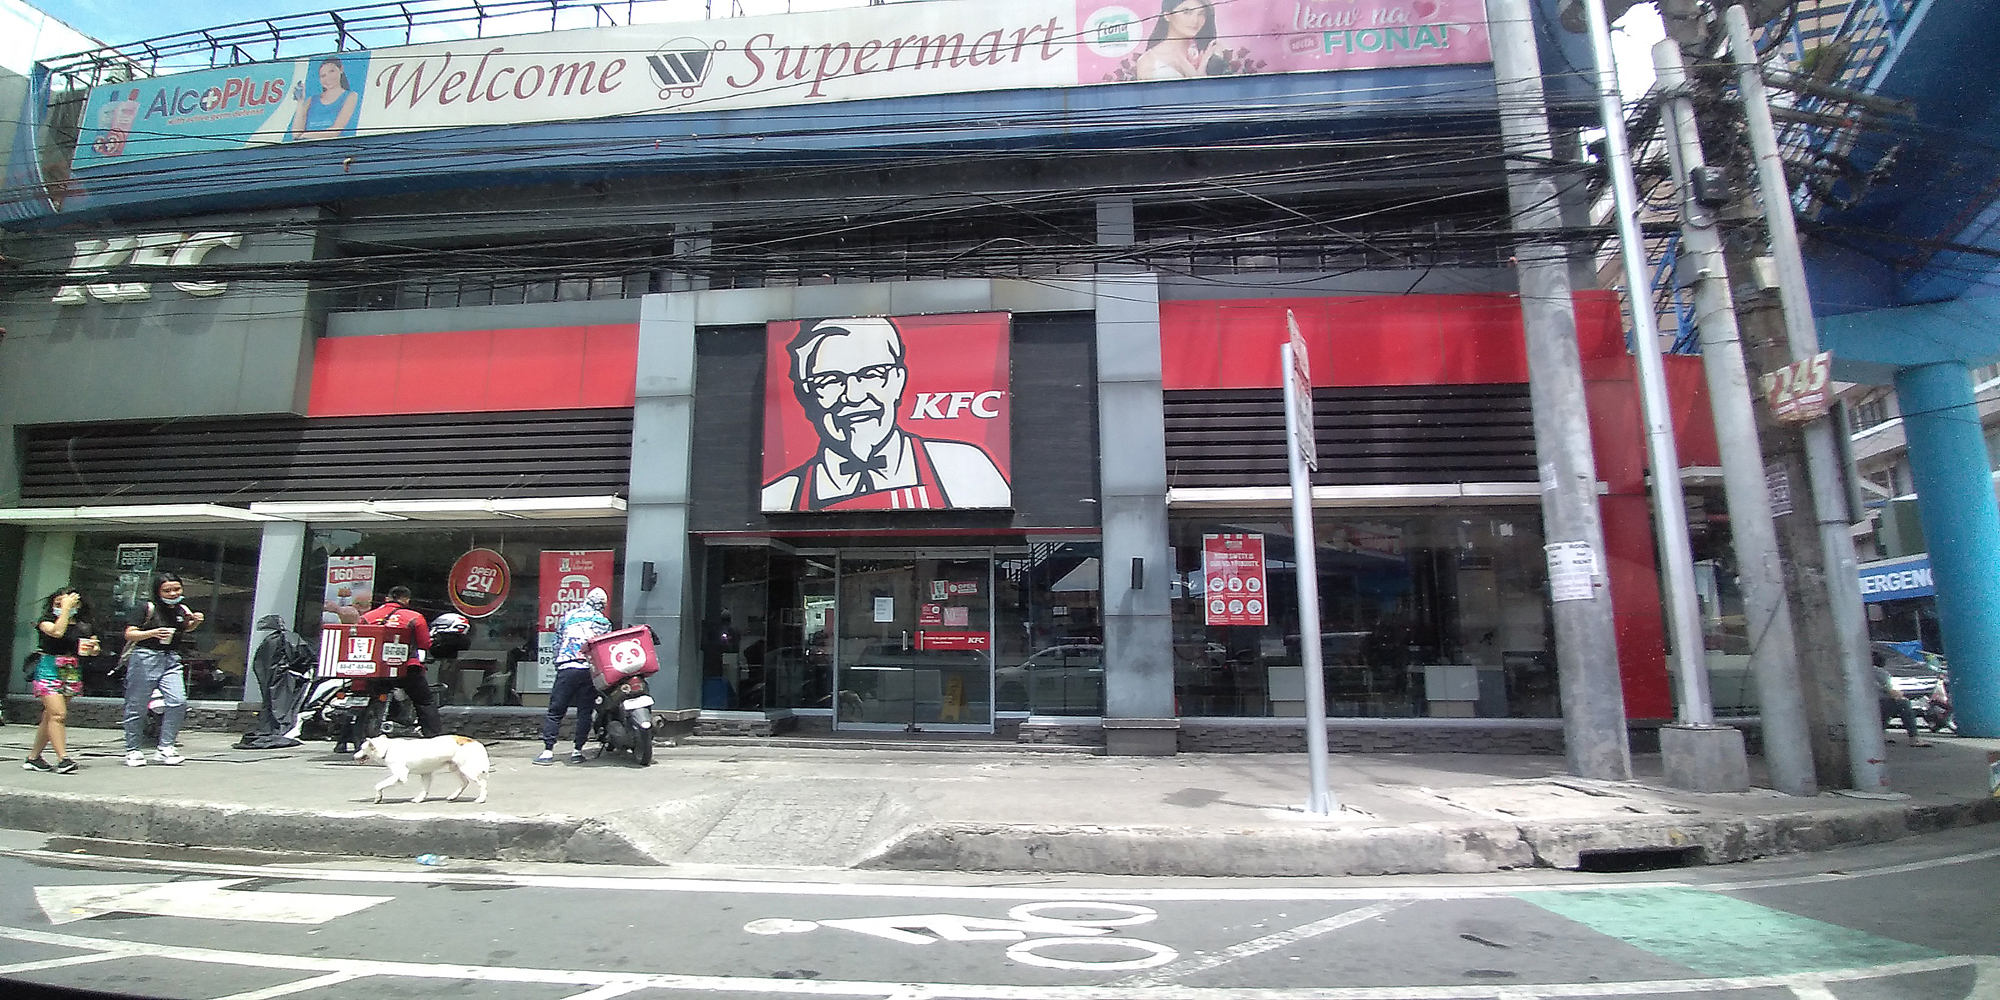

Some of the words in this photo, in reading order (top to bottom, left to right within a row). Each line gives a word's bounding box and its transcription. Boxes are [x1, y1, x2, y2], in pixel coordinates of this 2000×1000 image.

[1293, 2, 1362, 30] Ikaw
[1323, 24, 1449, 55] FIONA!
[375, 47, 627, 110] Welcome
[727, 16, 1064, 98] Supermart
[144, 78, 286, 120] AlcoPlus
[51, 231, 243, 306] KFC
[910, 390, 1002, 420] KFC
[466, 574, 494, 592] 24
[471, 566, 497, 577] OPEN
[967, 636, 985, 644] KFC
